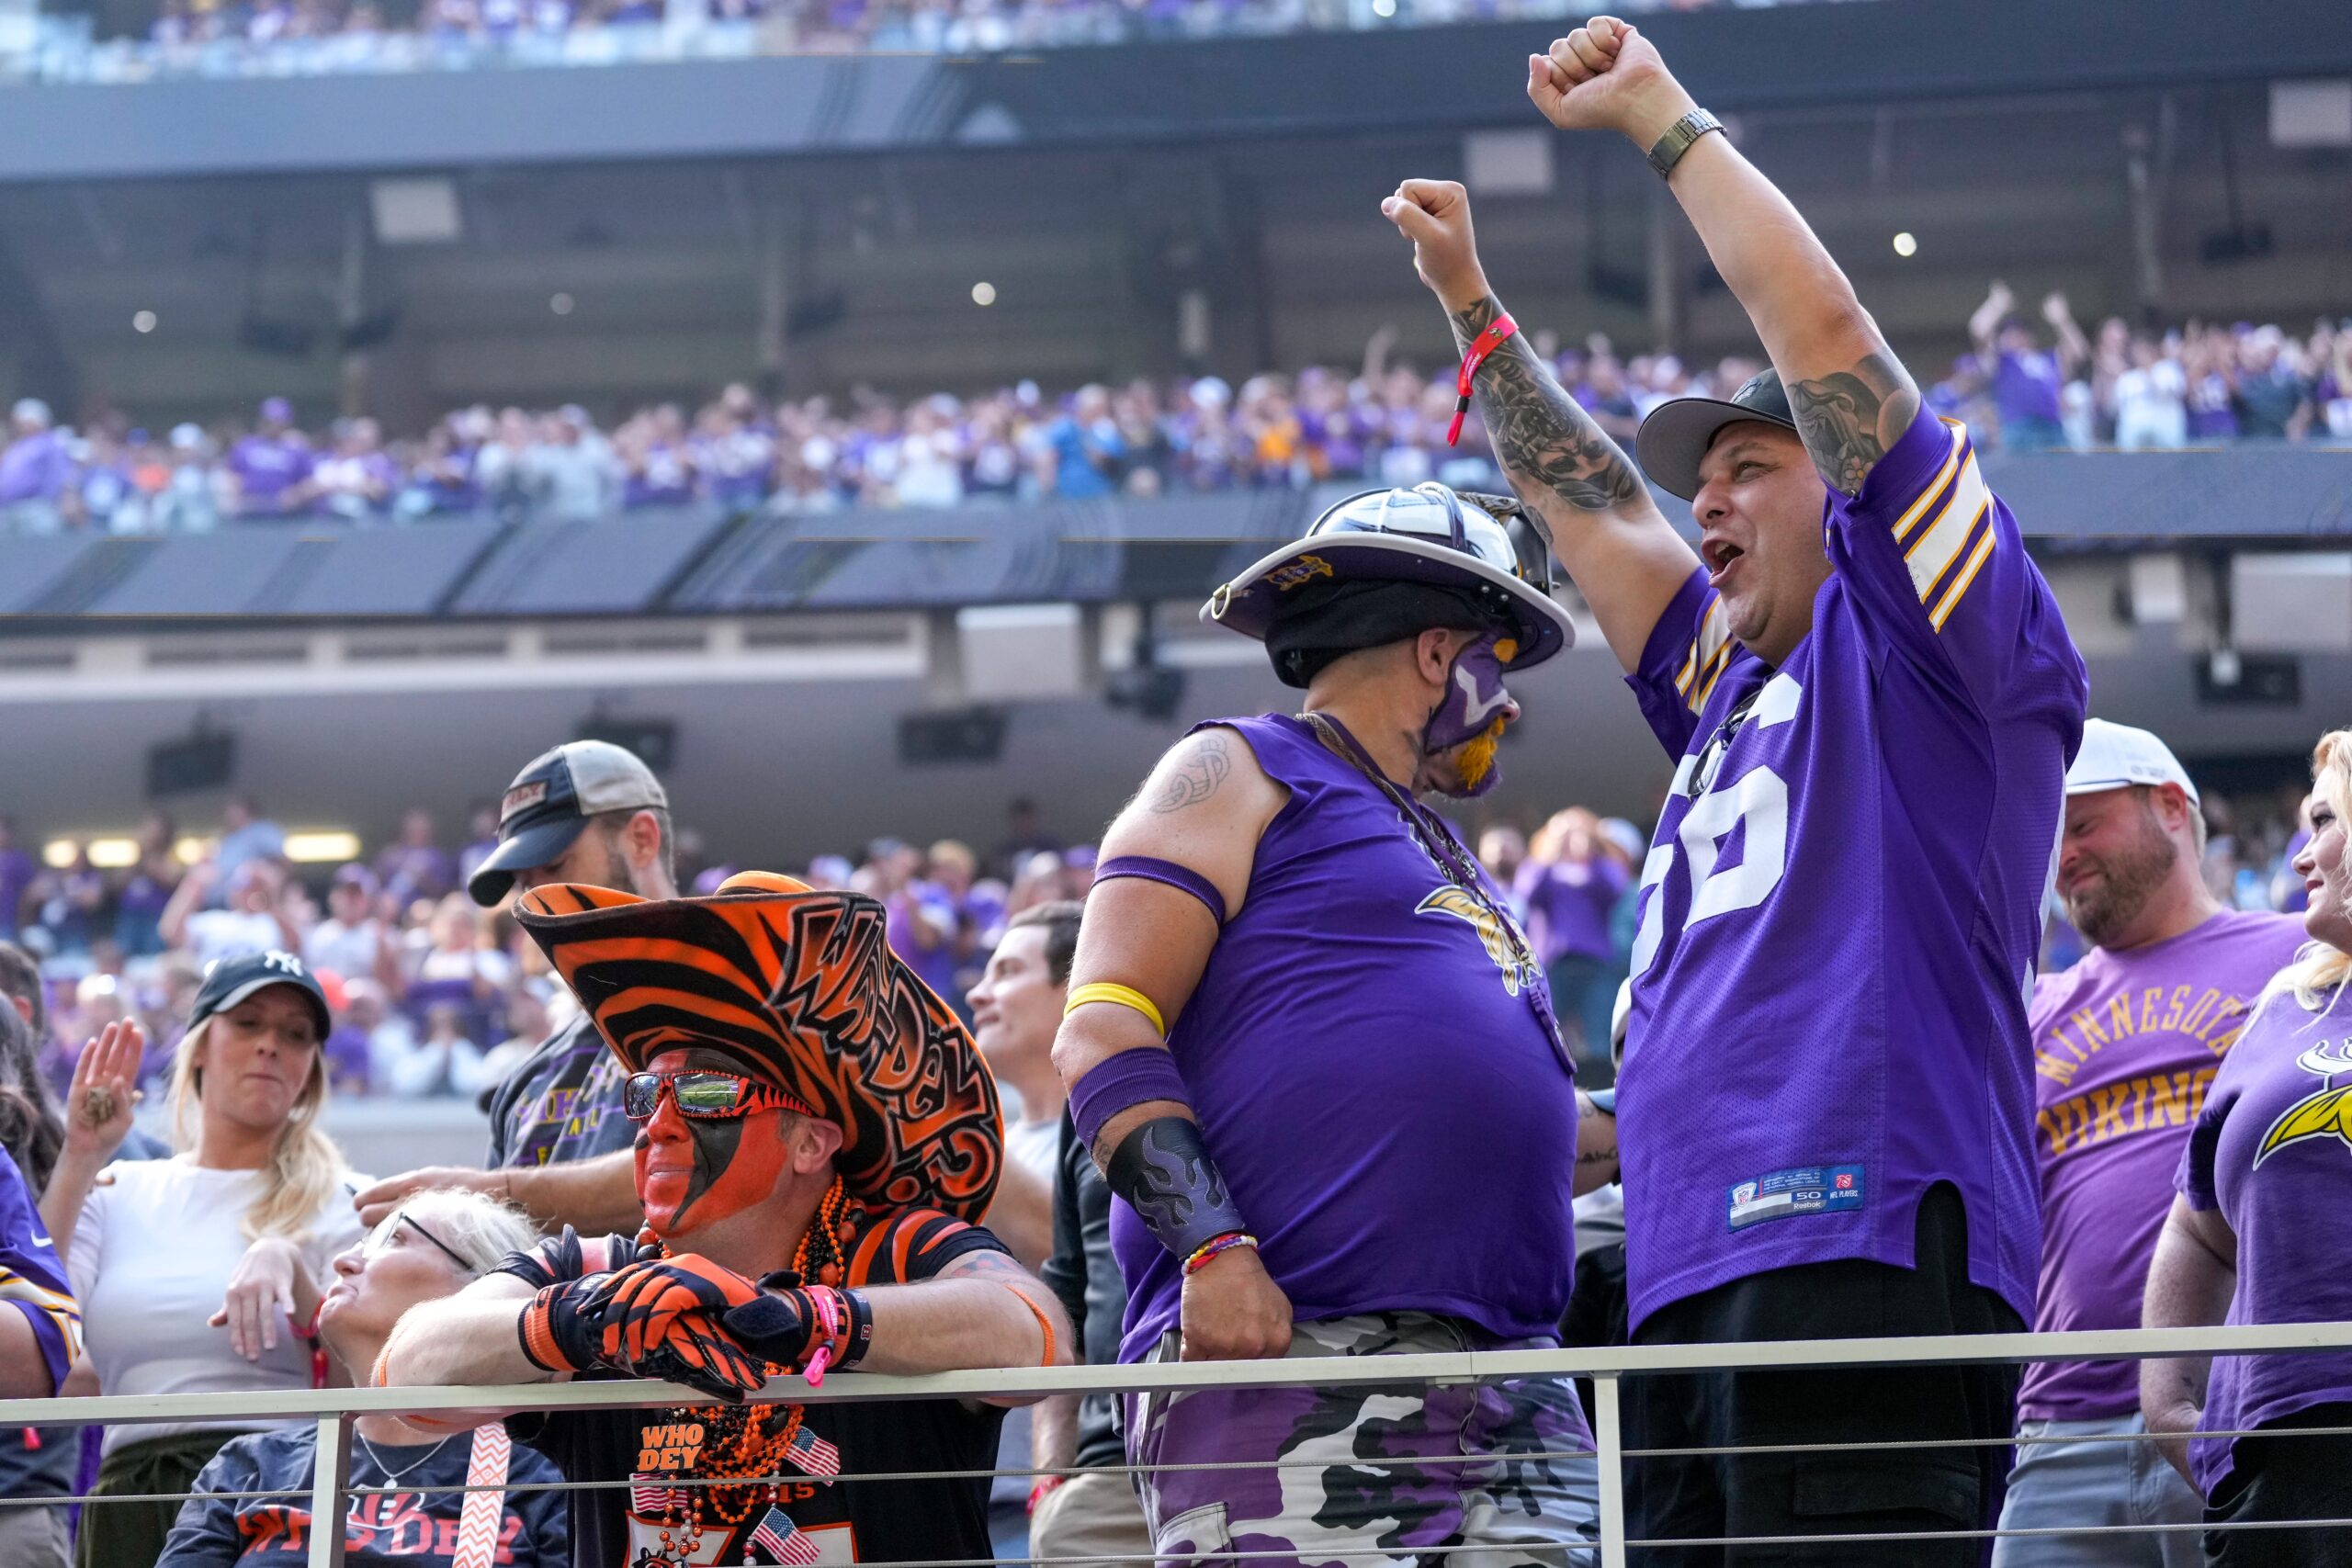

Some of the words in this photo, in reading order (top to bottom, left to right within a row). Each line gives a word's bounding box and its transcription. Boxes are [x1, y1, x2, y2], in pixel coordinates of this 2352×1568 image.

[2035, 985, 2245, 1087] MINNESOTA
[1793, 1201, 1821, 1210] Reebok
[1796, 1191, 1822, 1201] 50
[642, 1424, 704, 1449] WHO
[637, 1447, 704, 1472] DEY
